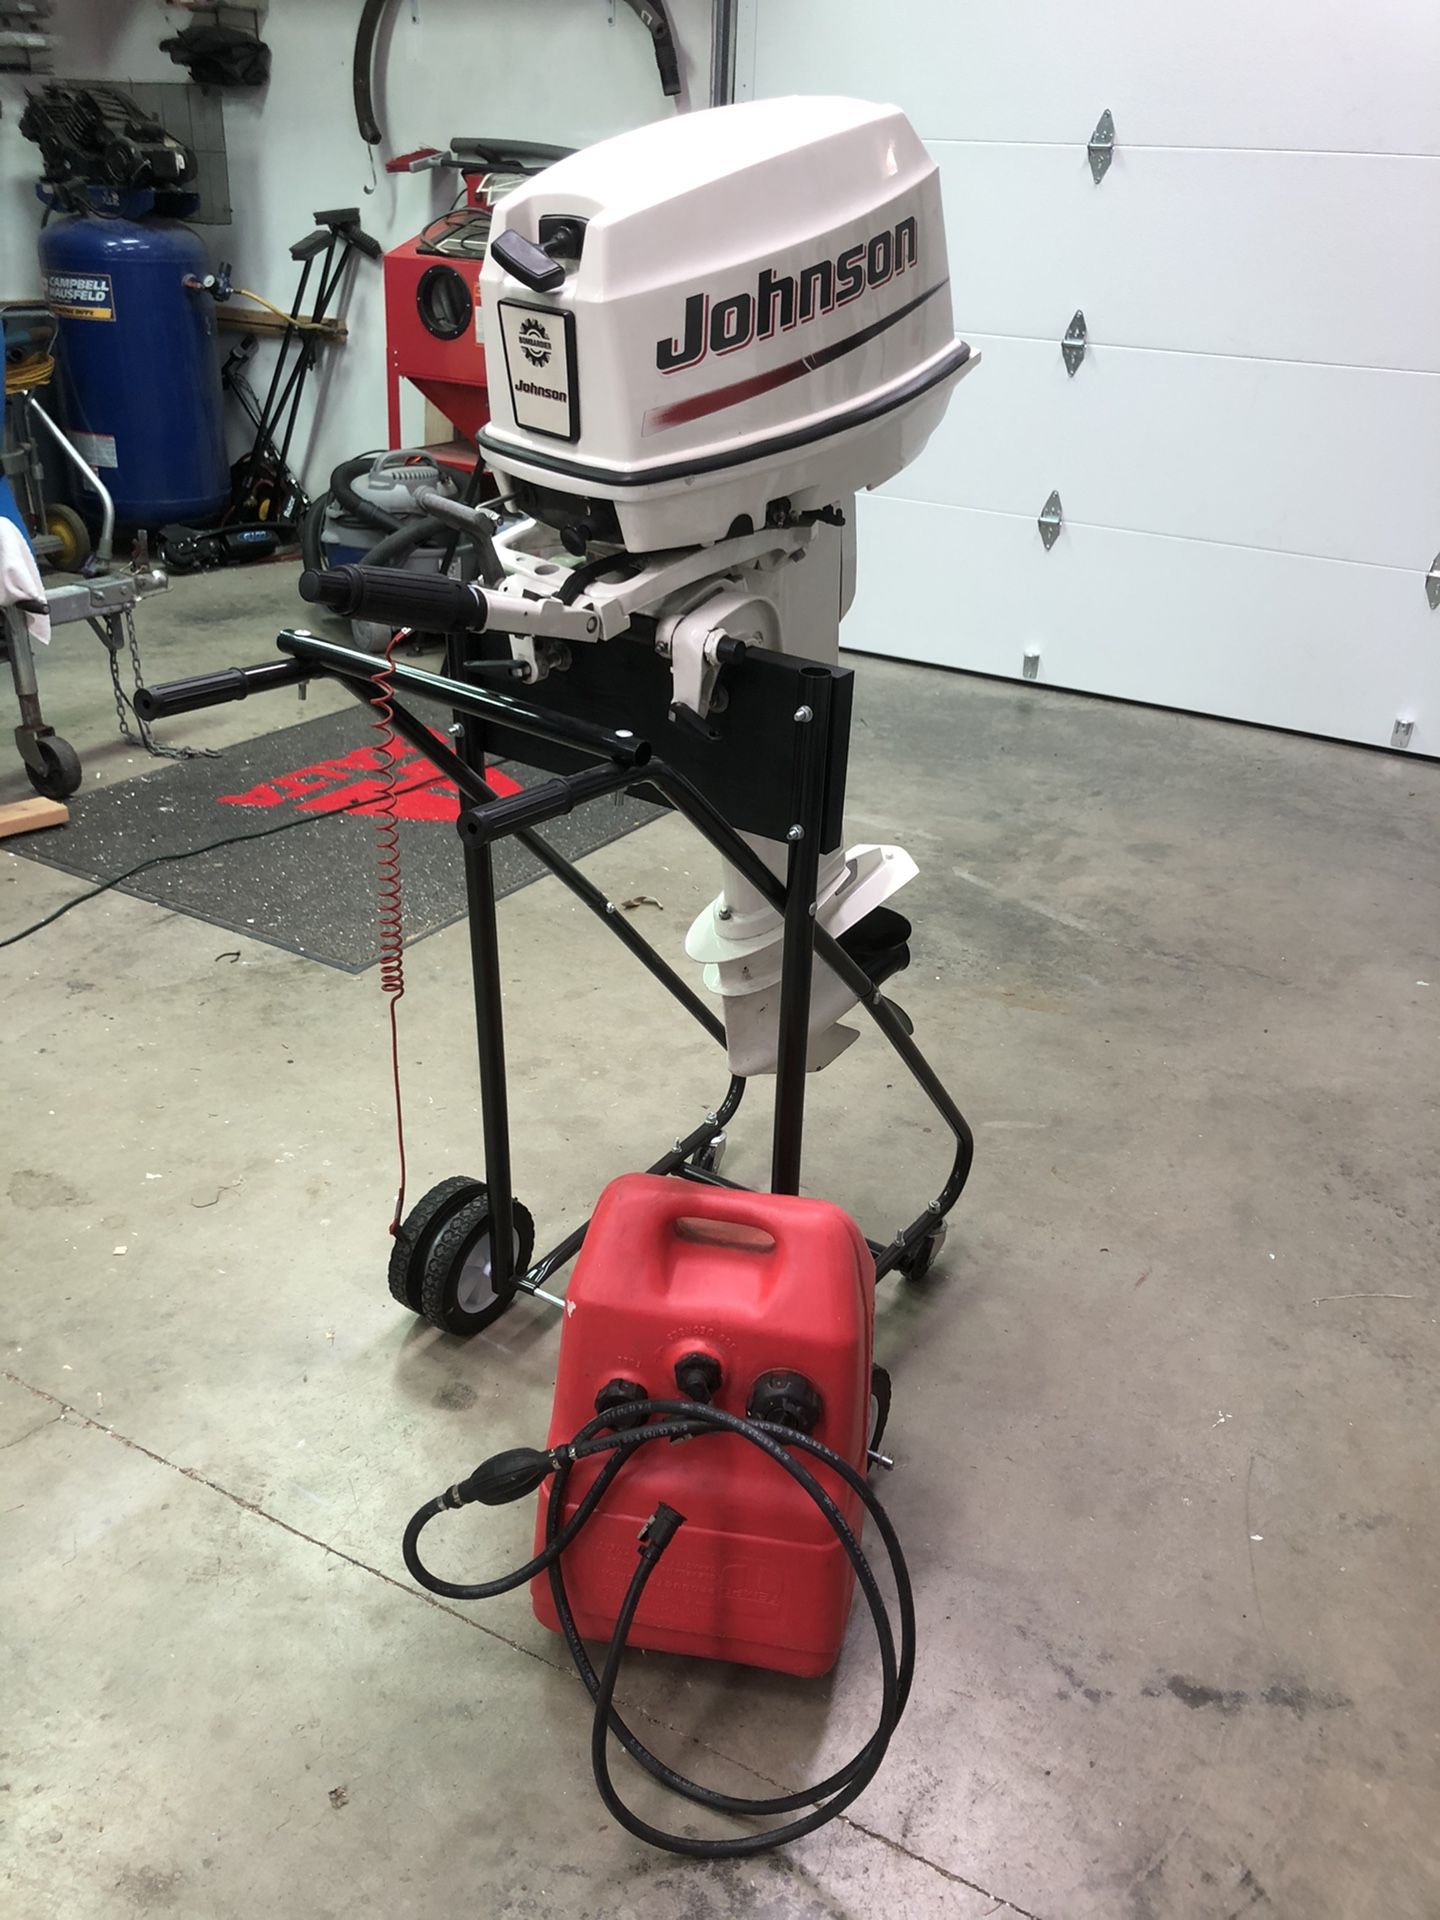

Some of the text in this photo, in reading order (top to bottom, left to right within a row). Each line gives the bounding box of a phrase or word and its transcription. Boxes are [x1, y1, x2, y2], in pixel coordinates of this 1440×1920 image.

[49, 276, 110, 292] CAMPBELL
[656, 216, 917, 375] Johnson
[514, 379, 568, 404] Johnson
